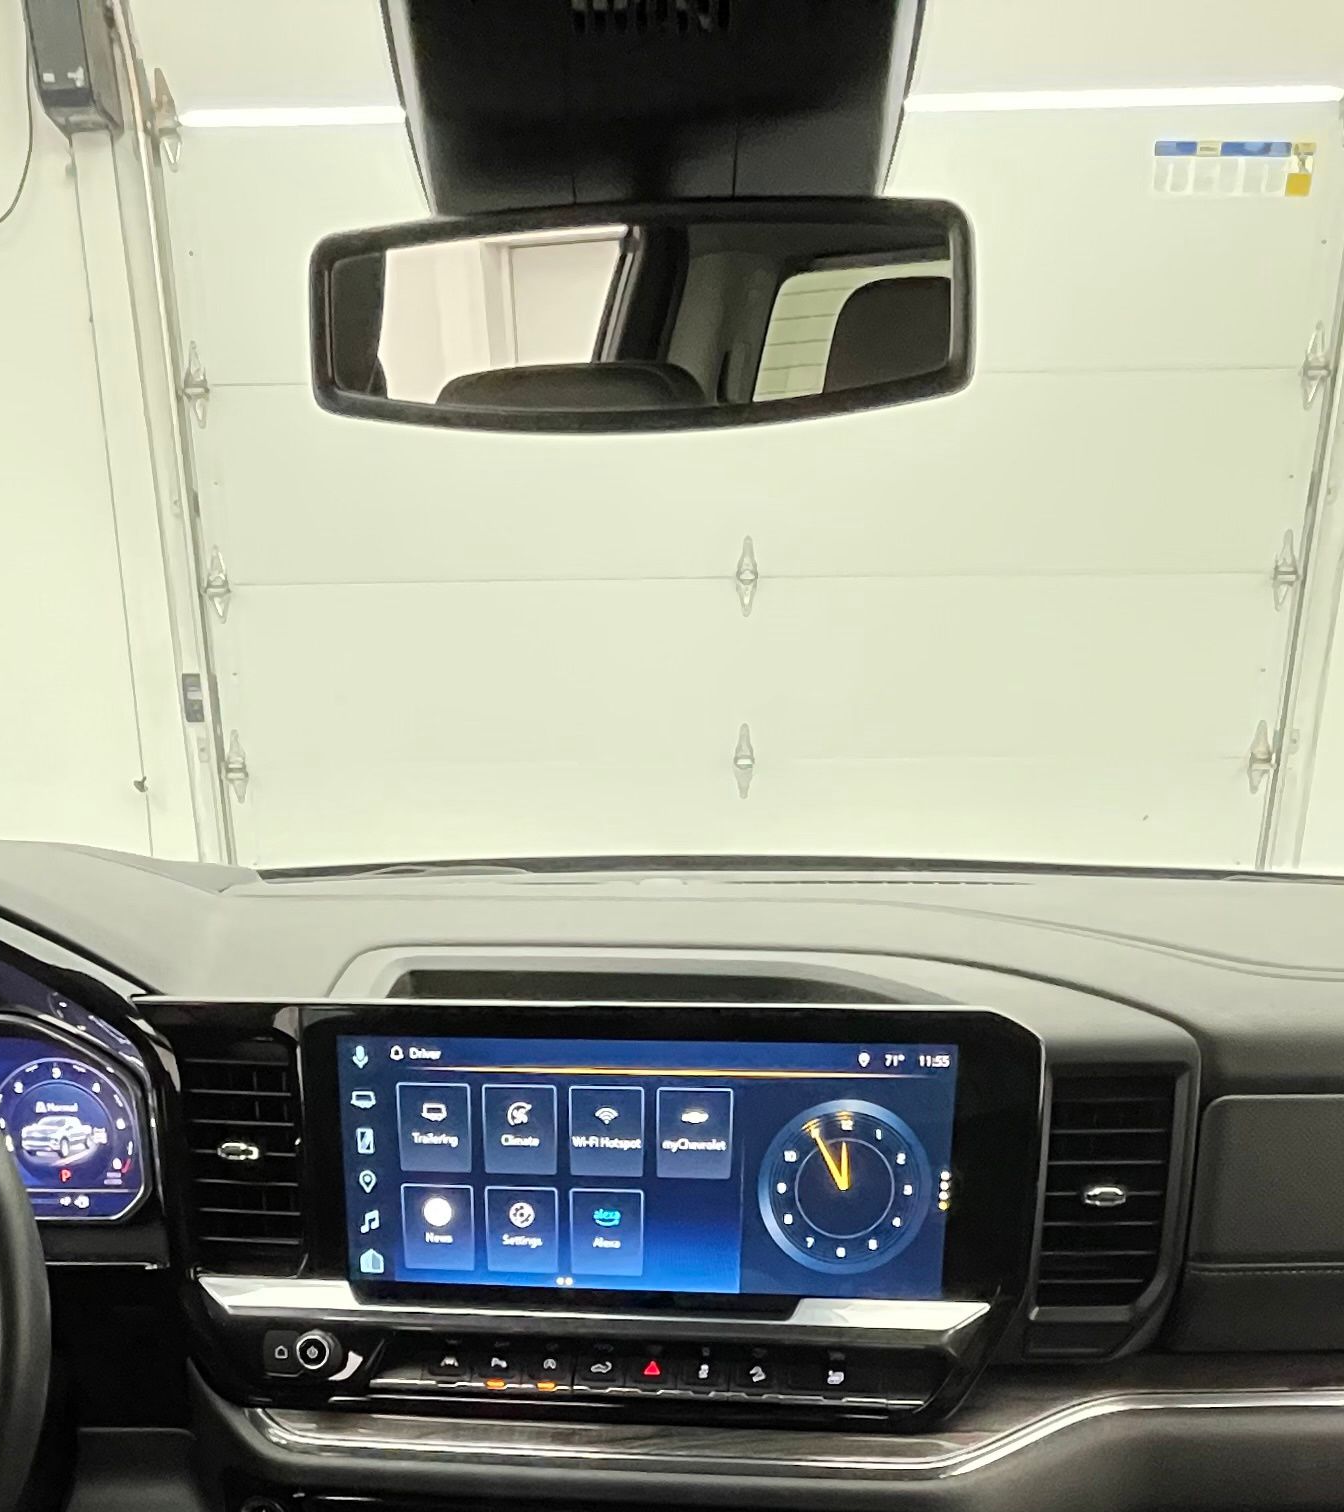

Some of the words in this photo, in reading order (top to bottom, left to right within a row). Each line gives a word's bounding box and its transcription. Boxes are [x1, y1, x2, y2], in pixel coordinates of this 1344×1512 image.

[409, 1047, 441, 1060] Driver
[919, 1055, 951, 1068] 11:55
[412, 1132, 458, 1147] Trailering
[501, 1134, 540, 1147] Climate
[600, 1136, 642, 1150] Hotspot
[662, 1138, 727, 1152] myChevrolet
[60, 1169, 72, 1182] P
[425, 1232, 454, 1244] News
[502, 1234, 543, 1248] Settings
[593, 1237, 621, 1249] Alexa
